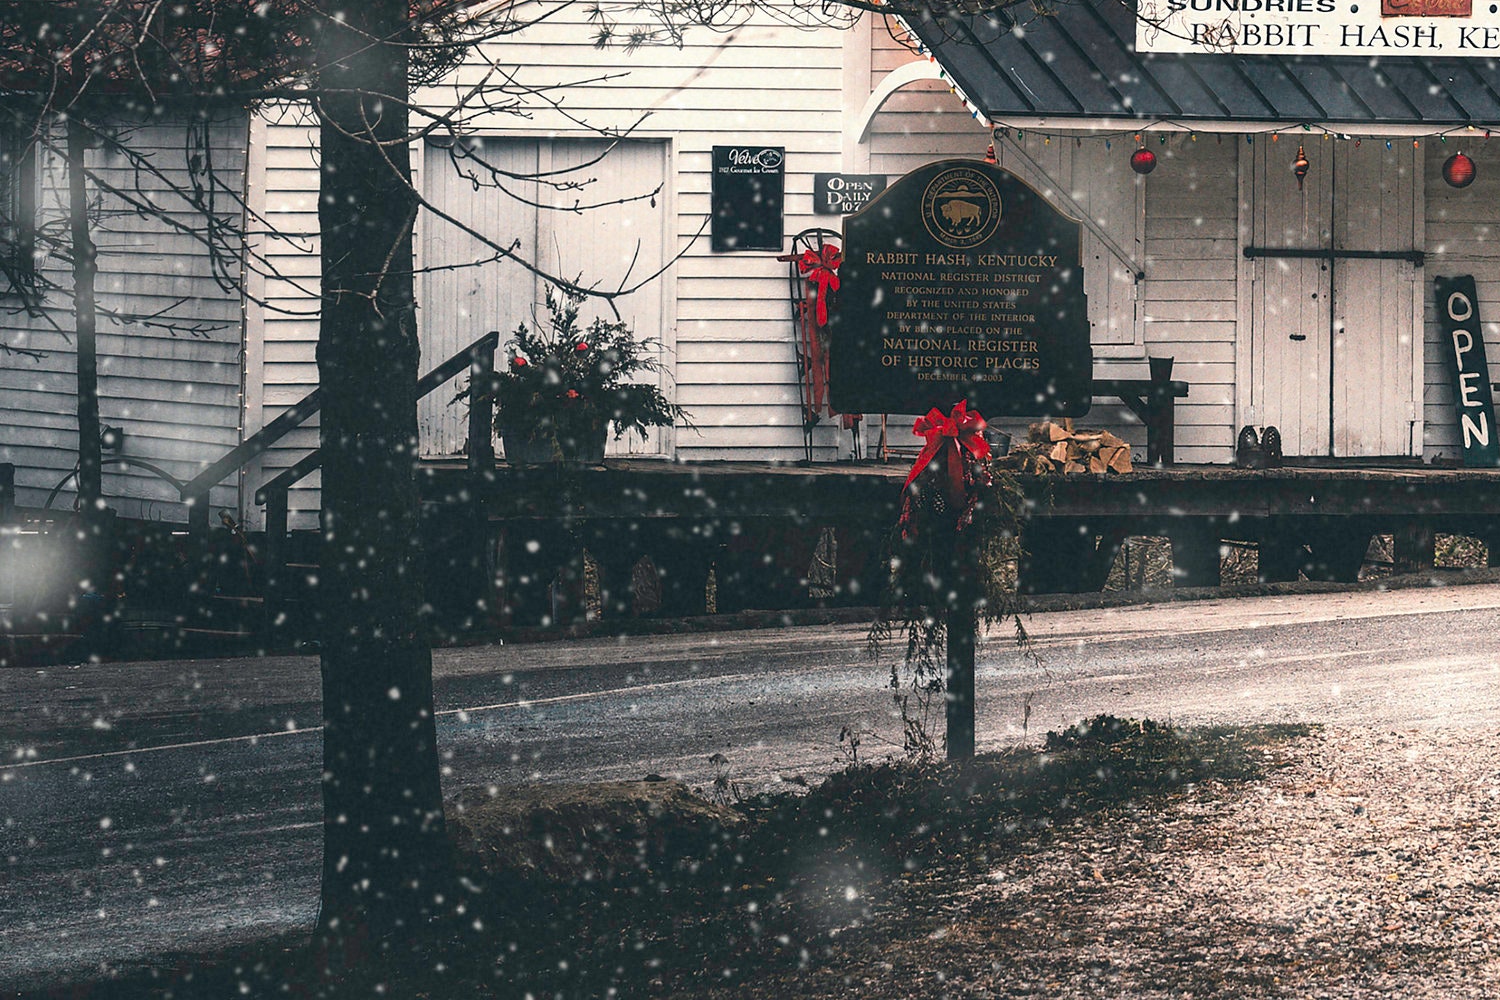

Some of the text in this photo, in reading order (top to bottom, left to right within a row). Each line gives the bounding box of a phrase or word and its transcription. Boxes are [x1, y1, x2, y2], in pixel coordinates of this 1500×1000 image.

[1190, 22, 1321, 48] RABBIT
[1339, 24, 1443, 51] HASH,
[827, 177, 873, 191] OPEN
[826, 191, 871, 205] DAILY
[866, 252, 1058, 267] RABBIT HASH, KENTUCKY
[881, 271, 1042, 283] NATIONAL REGISTER DISTRICT
[894, 286, 1029, 297] RECOGNIZED AND HONORED
[906, 299, 1017, 310] BY THE UNITED STATES
[886, 311, 1036, 323] DEPARTMENT OF THE INTERIOR
[899, 325, 1023, 336] BY BEING PLACED ON THE
[883, 338, 1038, 353] NATIONAL REGISTER
[881, 354, 1040, 370] OF HISTORIC PLACES
[917, 372, 967, 382] DECEMBER
[971, 373, 981, 382] 4
[1447, 291, 1490, 450] OPEN
